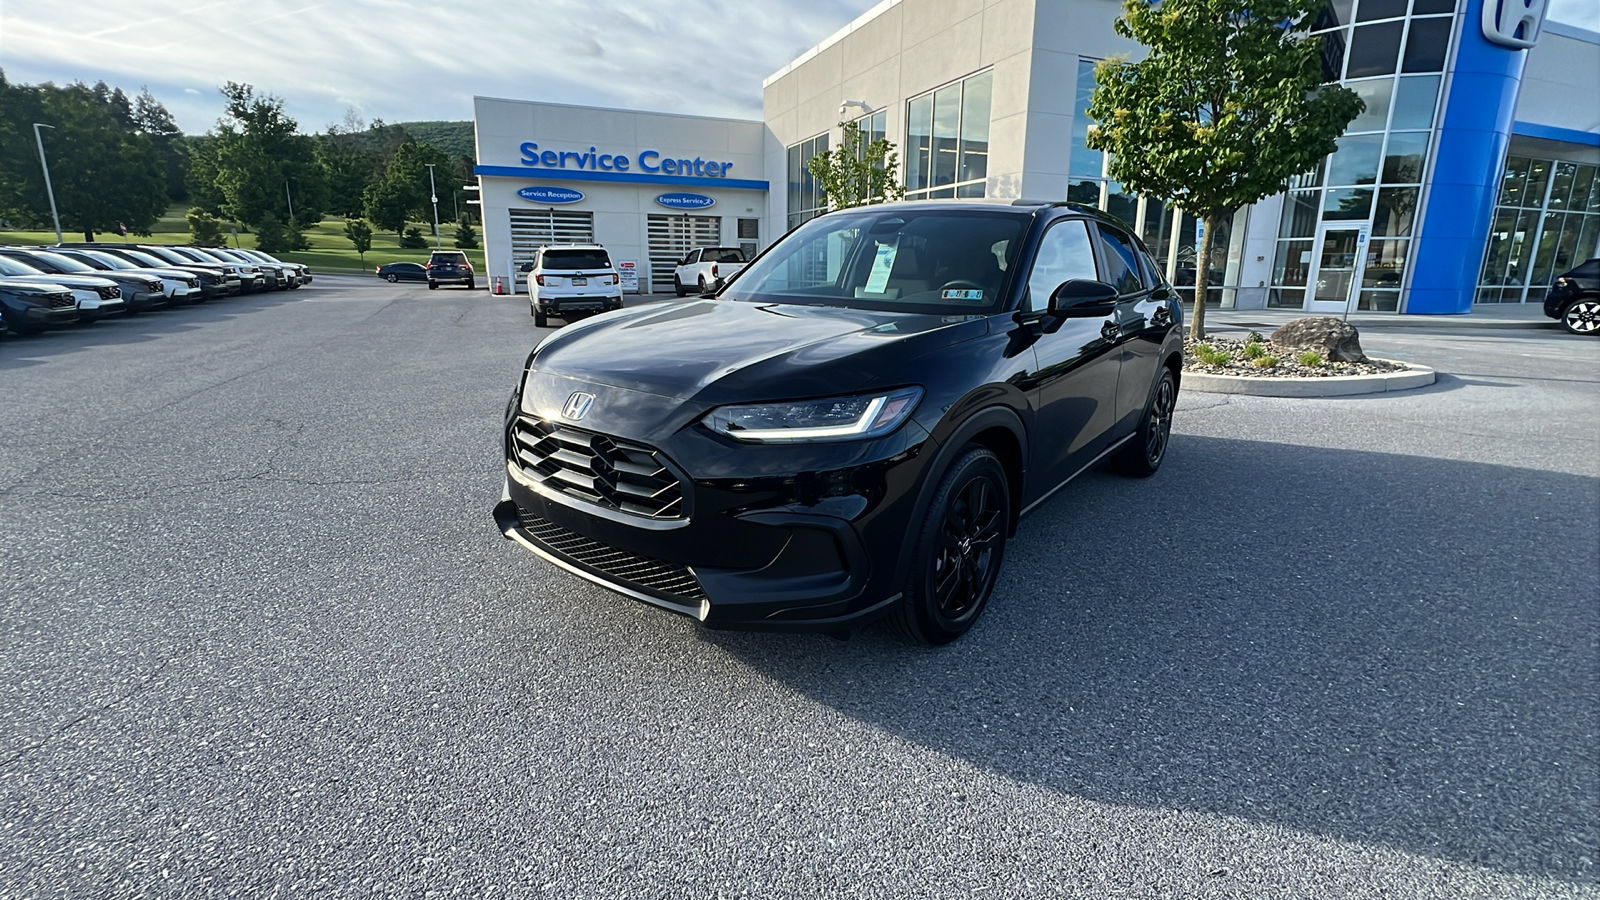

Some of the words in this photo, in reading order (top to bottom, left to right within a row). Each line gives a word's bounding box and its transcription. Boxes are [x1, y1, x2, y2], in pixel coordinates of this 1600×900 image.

[520, 142, 630, 172] Service
[638, 150, 734, 178] Center
[521, 190, 547, 198] Service
[547, 191, 581, 200] Reception
[659, 196, 682, 204] Express
